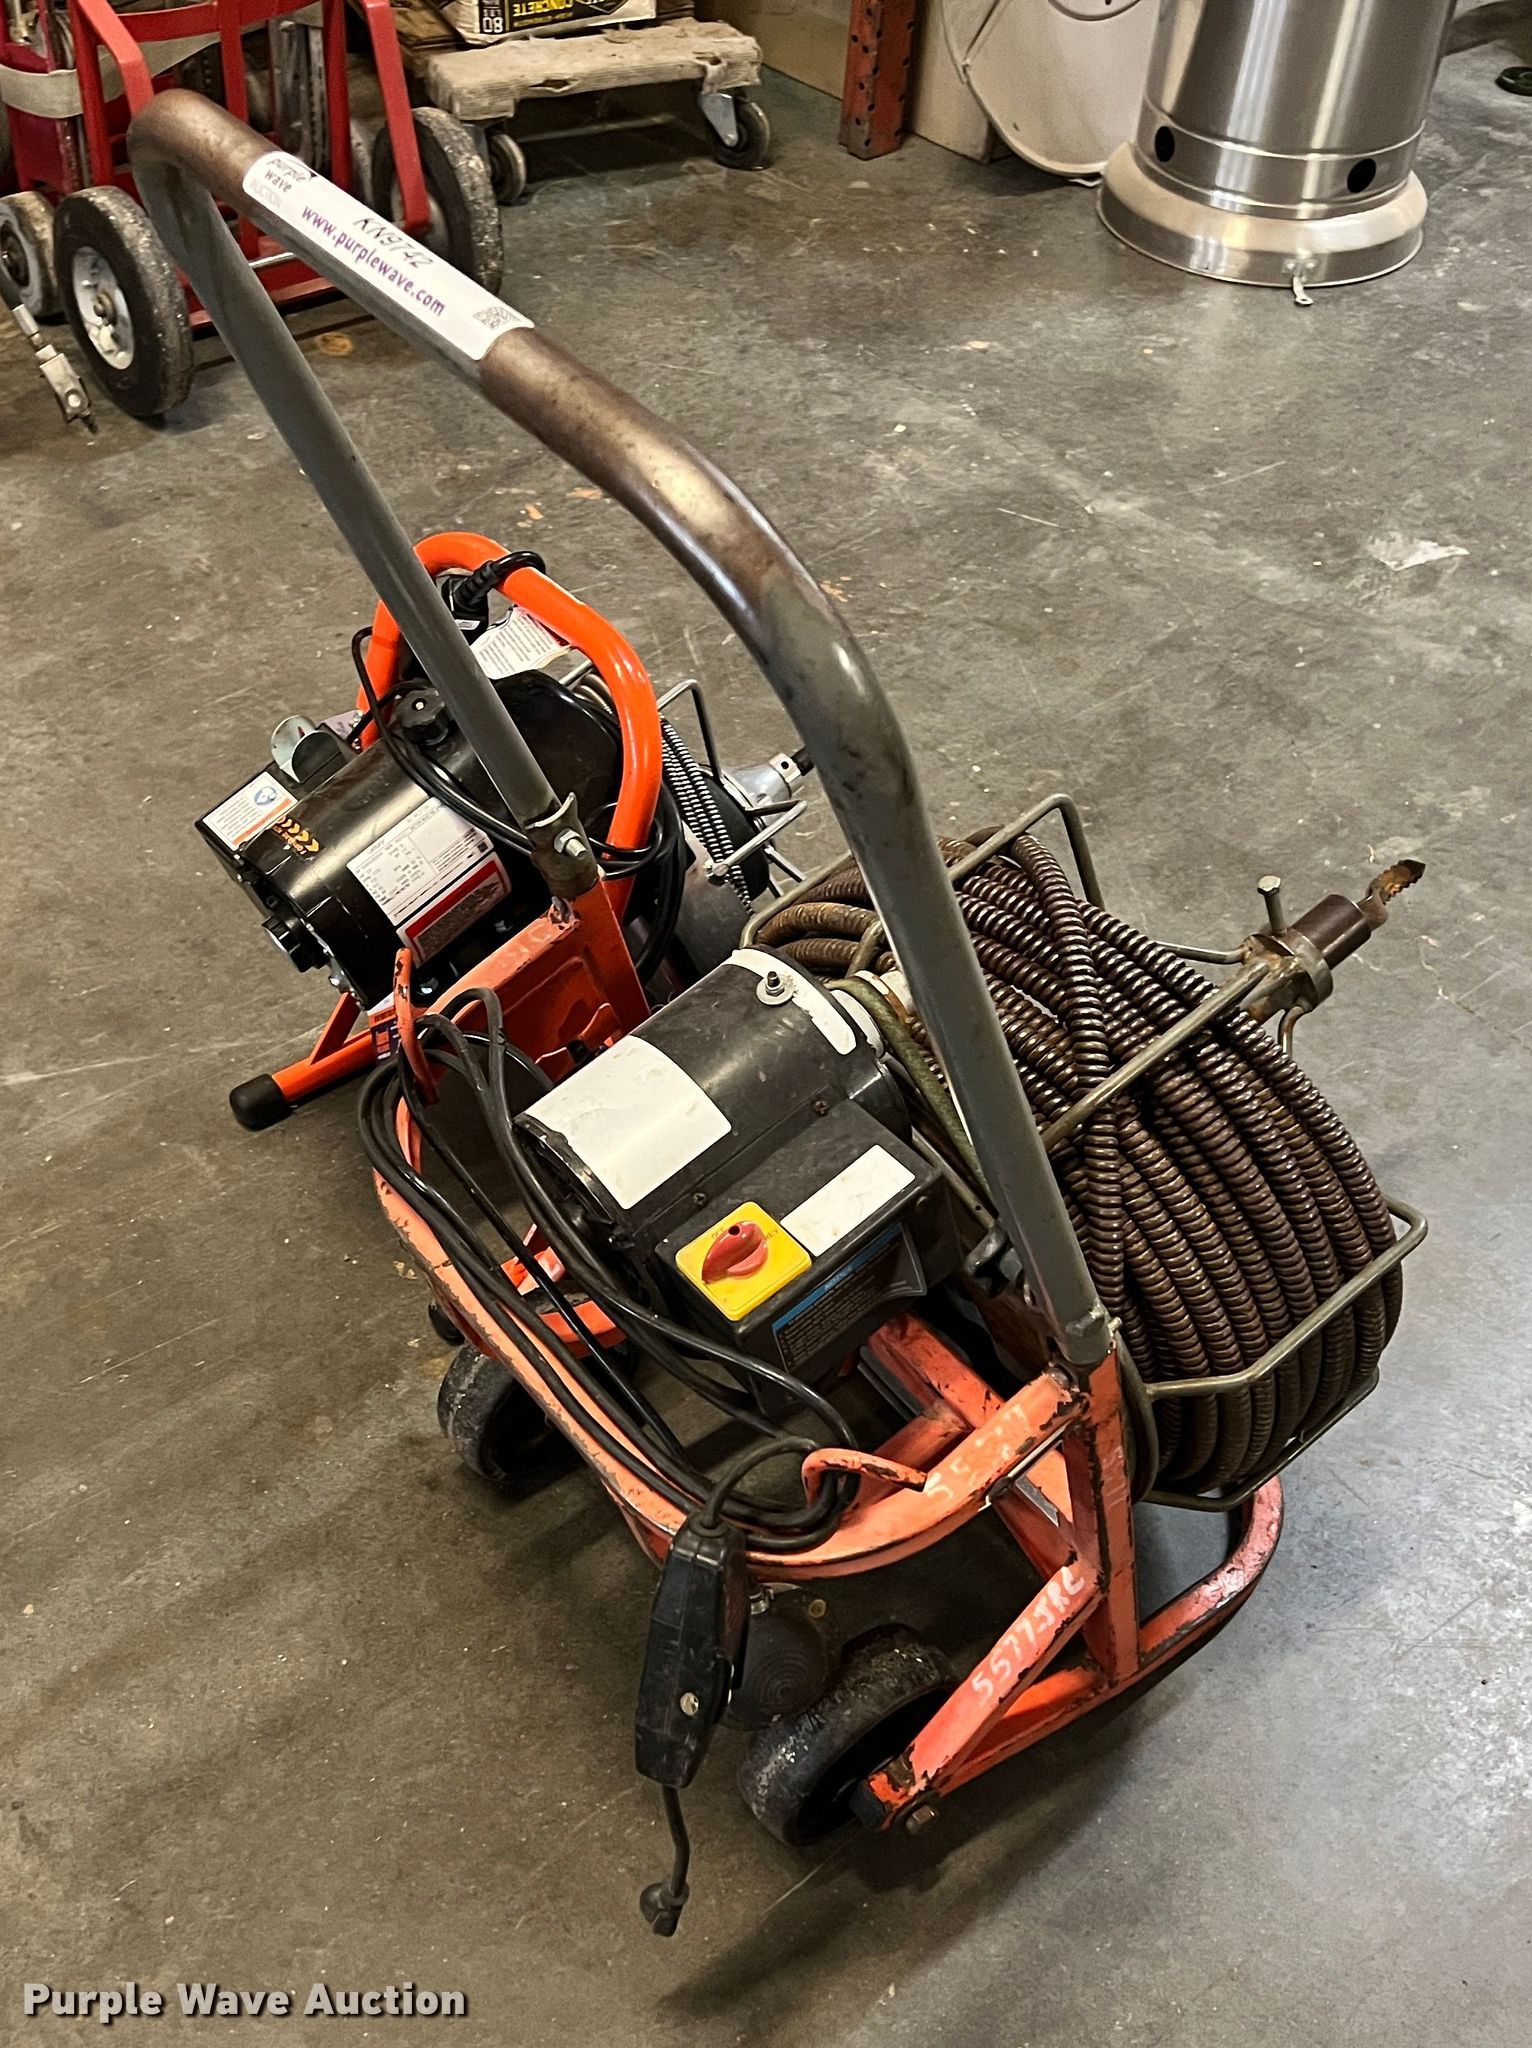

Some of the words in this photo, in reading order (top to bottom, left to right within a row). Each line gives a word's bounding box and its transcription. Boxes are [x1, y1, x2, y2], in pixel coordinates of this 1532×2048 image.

[482, 16, 503, 33] 80
[264, 169, 293, 192] wave
[302, 205, 446, 316] www.purplewave.com
